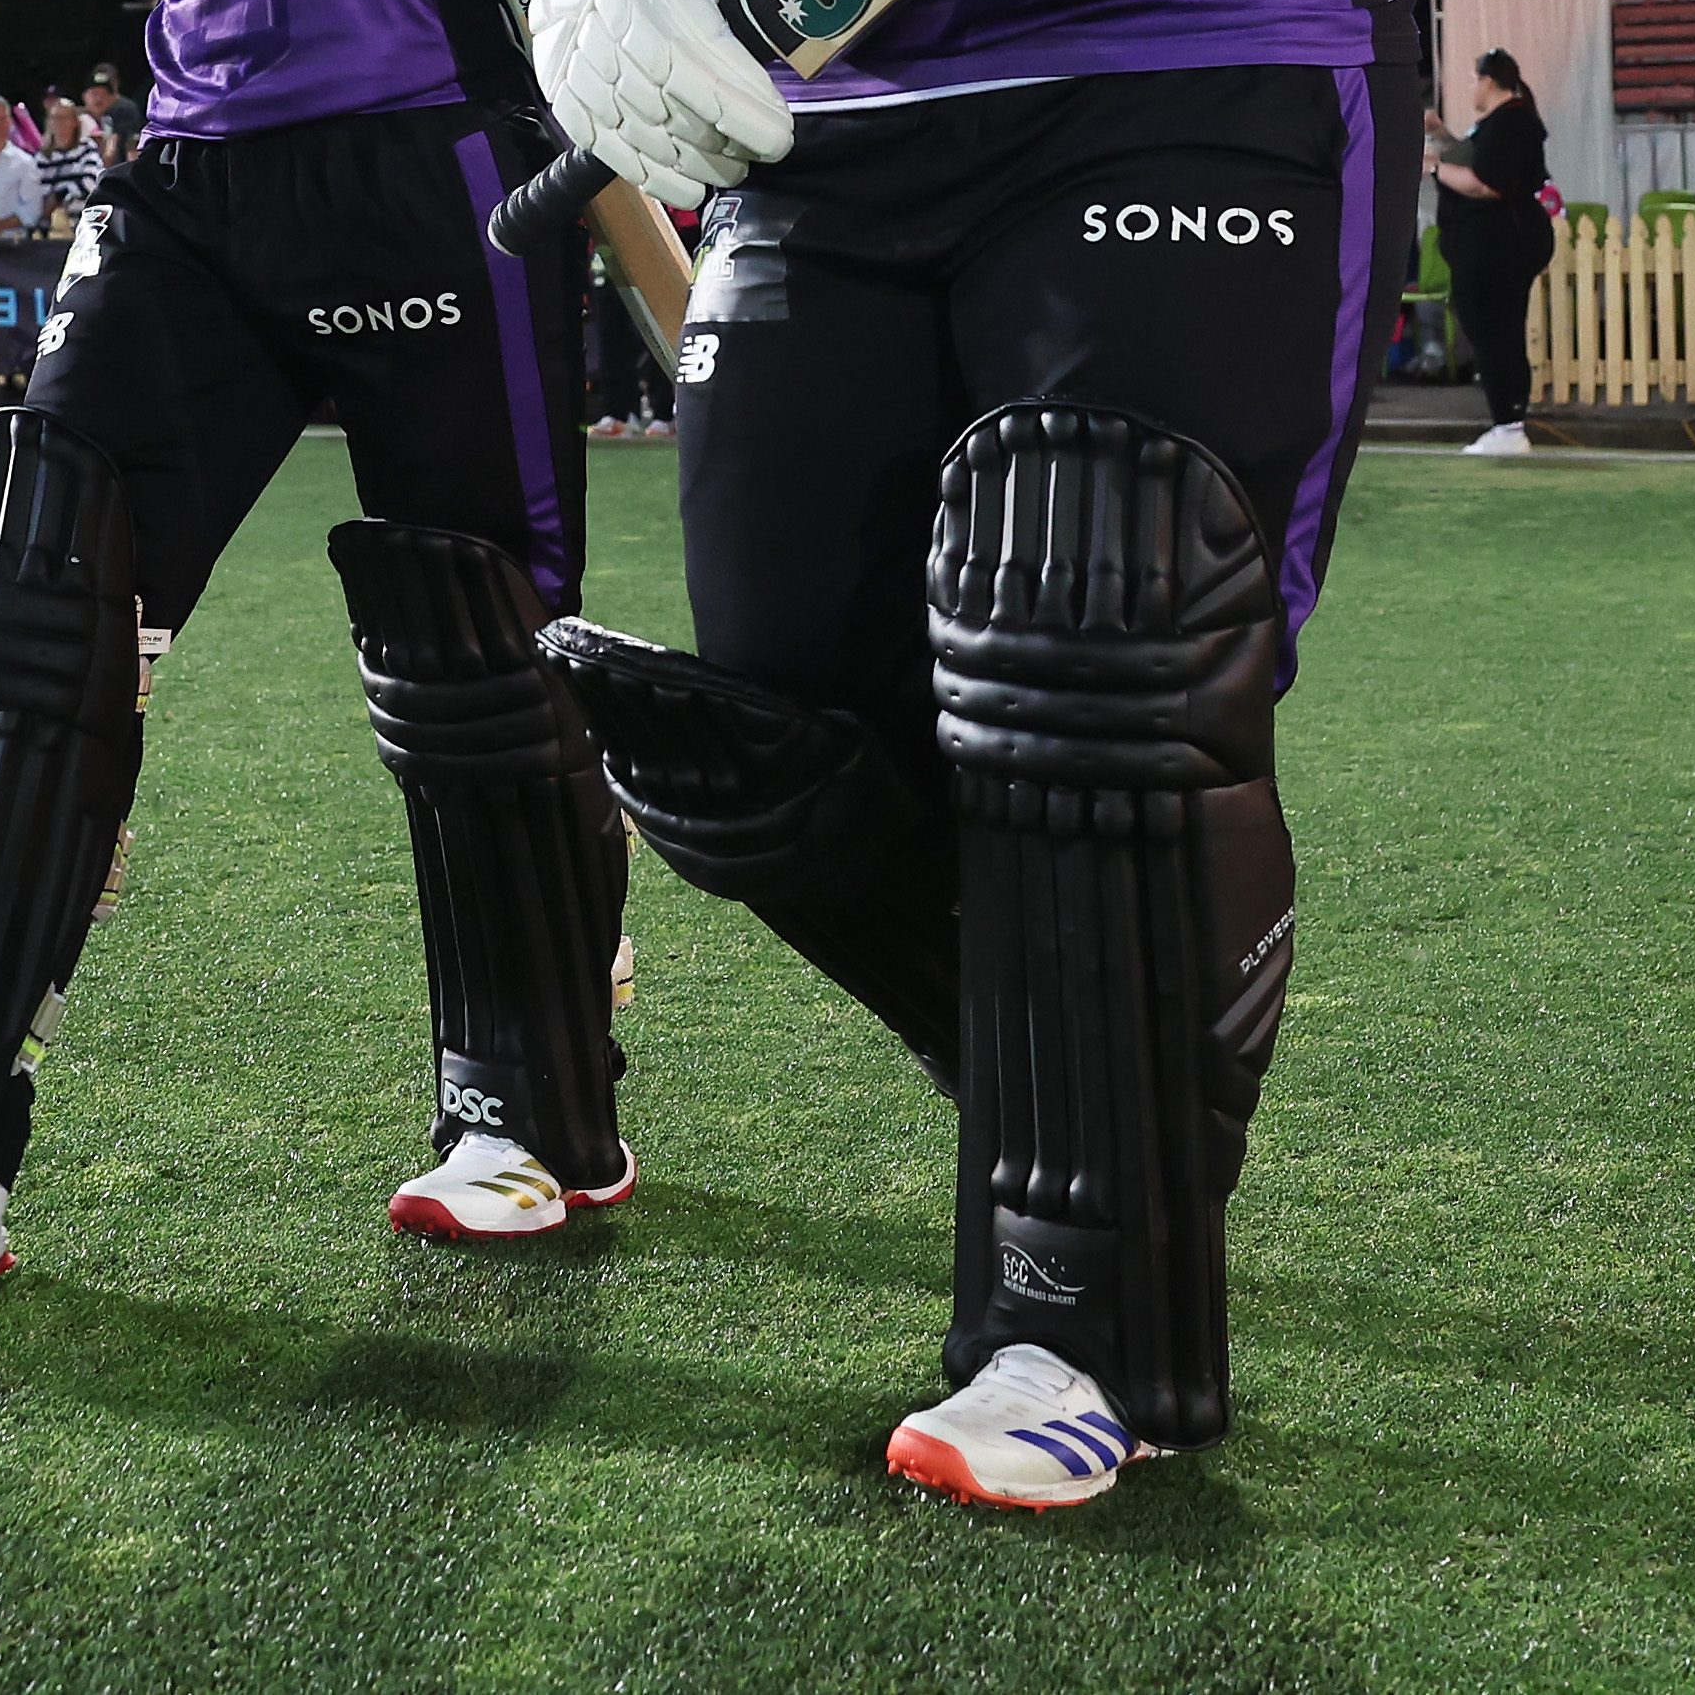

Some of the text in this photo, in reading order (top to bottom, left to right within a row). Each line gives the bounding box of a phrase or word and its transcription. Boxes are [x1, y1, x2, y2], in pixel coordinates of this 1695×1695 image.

[1083, 204, 1295, 245] SONOS
[309, 293, 461, 335] SONOS
[443, 1079, 504, 1126] DSC
[1002, 1252, 1029, 1285] SCC
